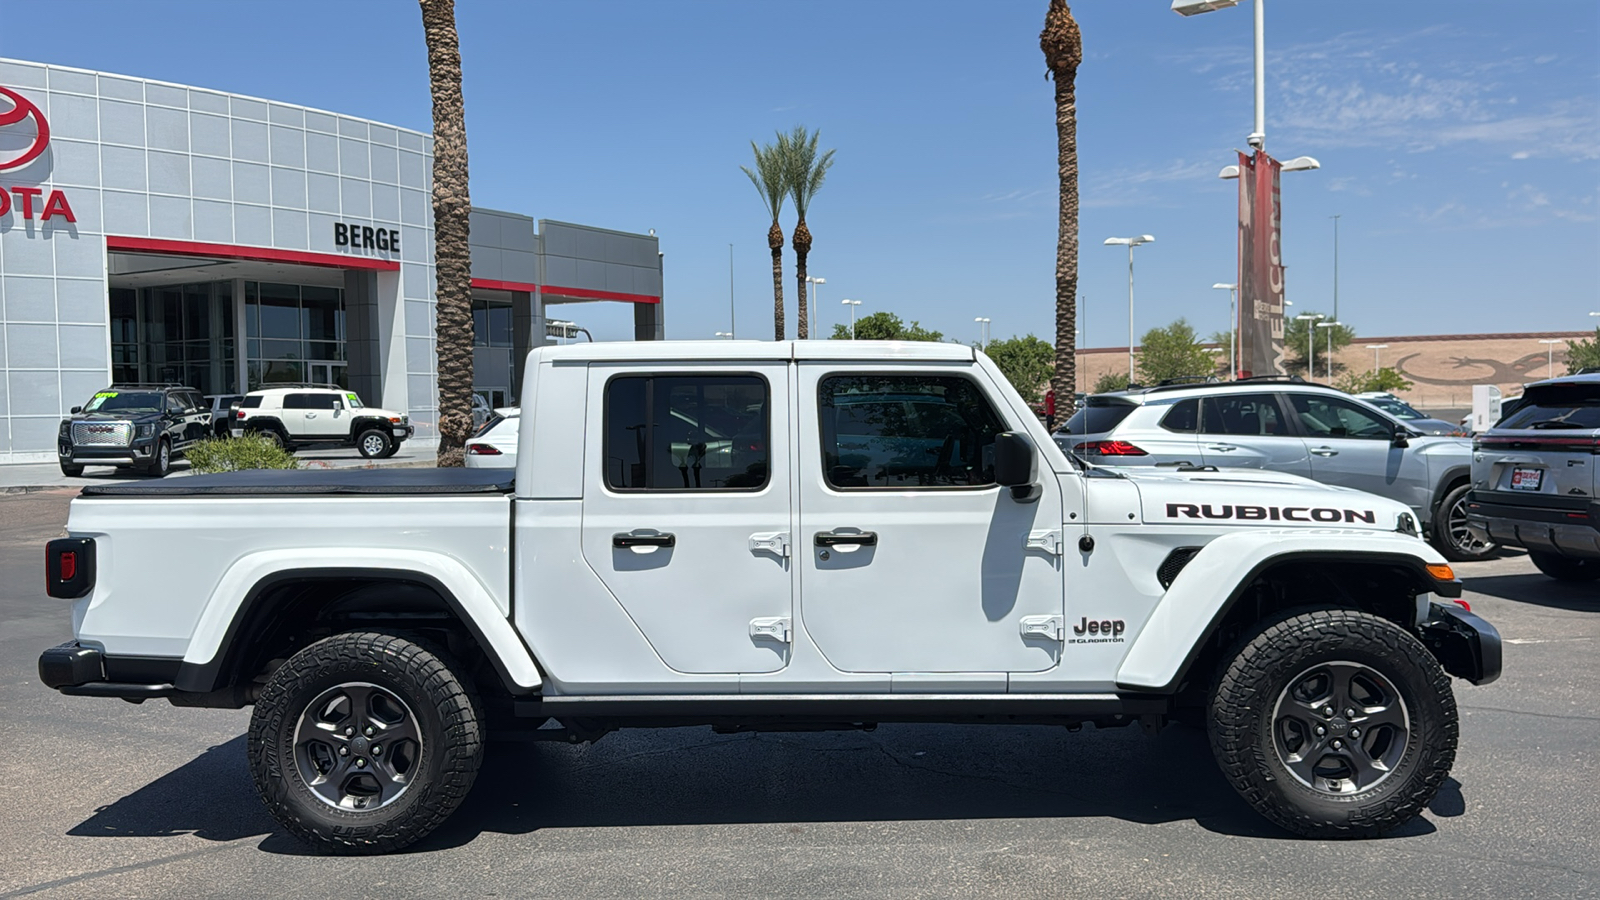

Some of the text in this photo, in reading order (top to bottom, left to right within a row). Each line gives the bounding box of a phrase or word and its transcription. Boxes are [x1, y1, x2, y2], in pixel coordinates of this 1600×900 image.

[334, 222, 400, 253] BERGE
[1166, 503, 1376, 524] RUBICON
[1073, 616, 1125, 637] Jeep
